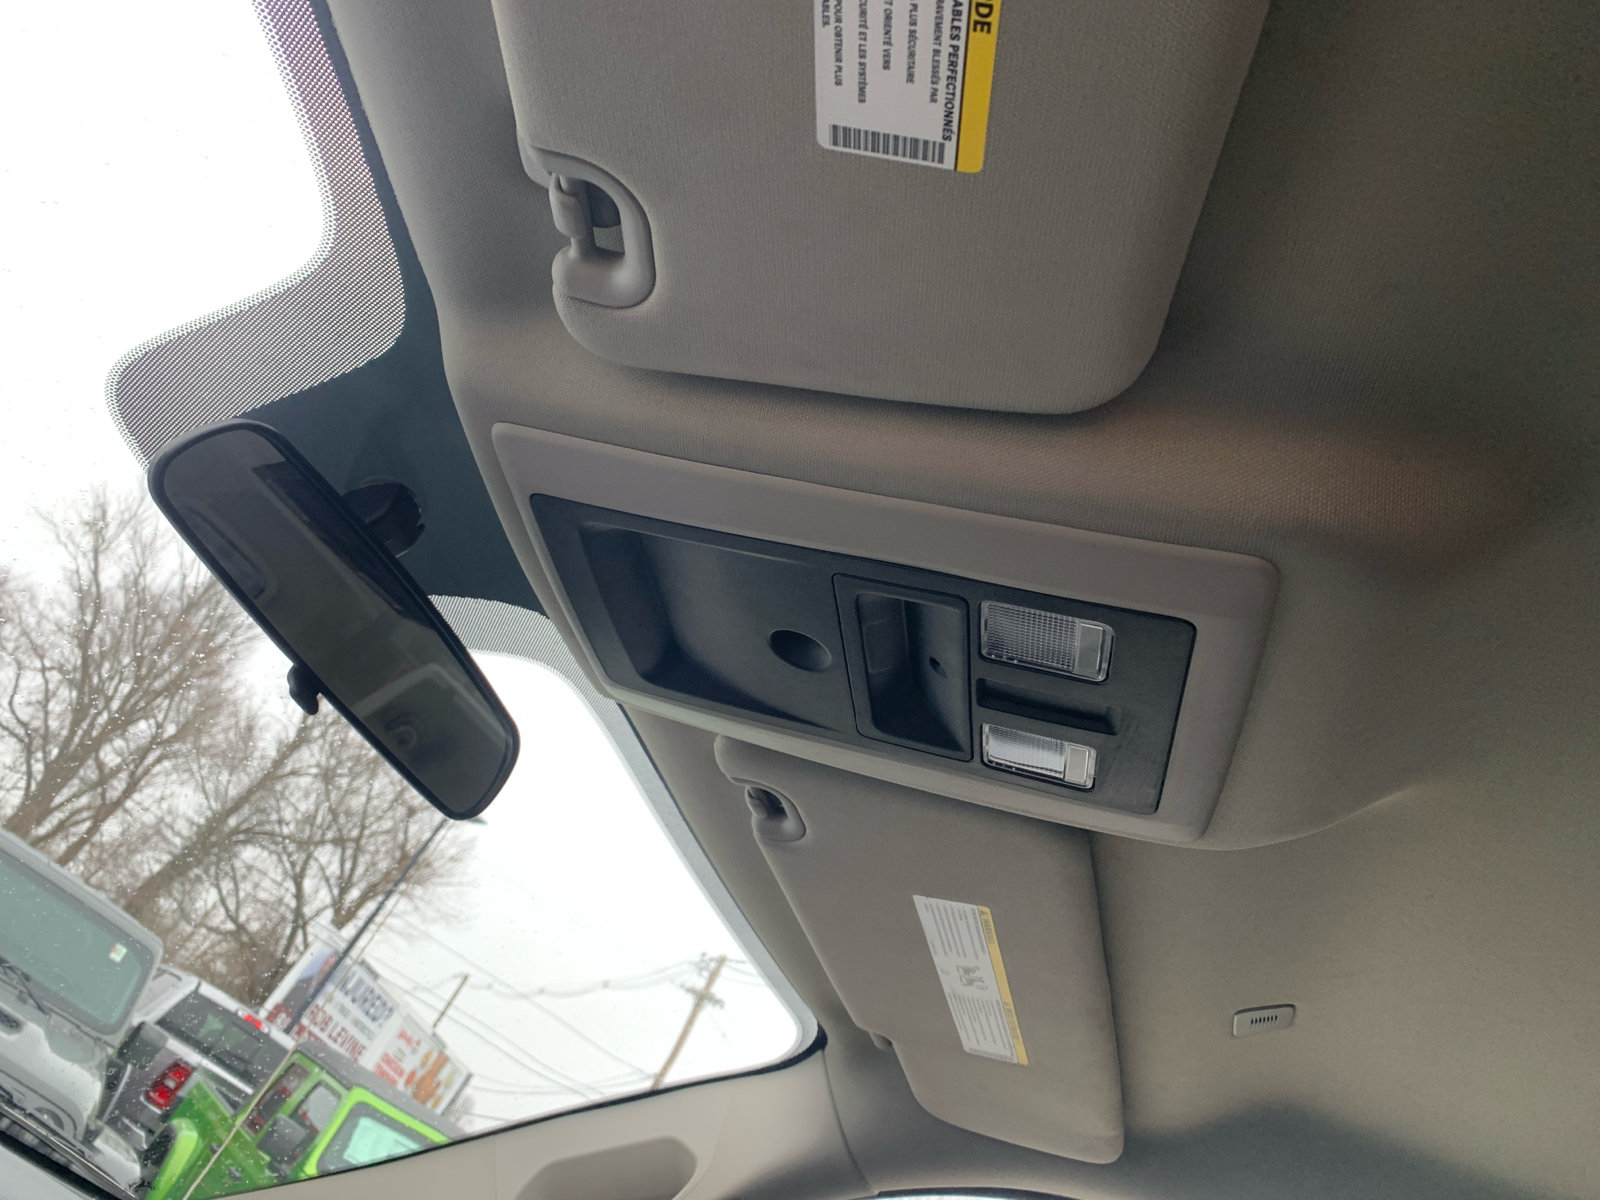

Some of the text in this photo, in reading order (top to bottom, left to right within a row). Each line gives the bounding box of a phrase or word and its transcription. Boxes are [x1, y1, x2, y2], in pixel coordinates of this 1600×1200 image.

[883, 8, 894, 47] ORIENTÉ
[972, 0, 994, 34] DE
[833, 26, 843, 63] OBTENIR
[858, 31, 867, 42] ET
[858, 43, 867, 60] LES
[906, 3, 919, 84] PLUS SÉCURITAIRE
[834, 65, 843, 87] PLUS
[882, 49, 891, 71] VERS
[931, 48, 942, 87] BLESSÉS
[857, 61, 869, 104] SYSTÈMES
[929, 88, 939, 104] PAR
[941, 44, 960, 142] PERFECTIONNÉS
